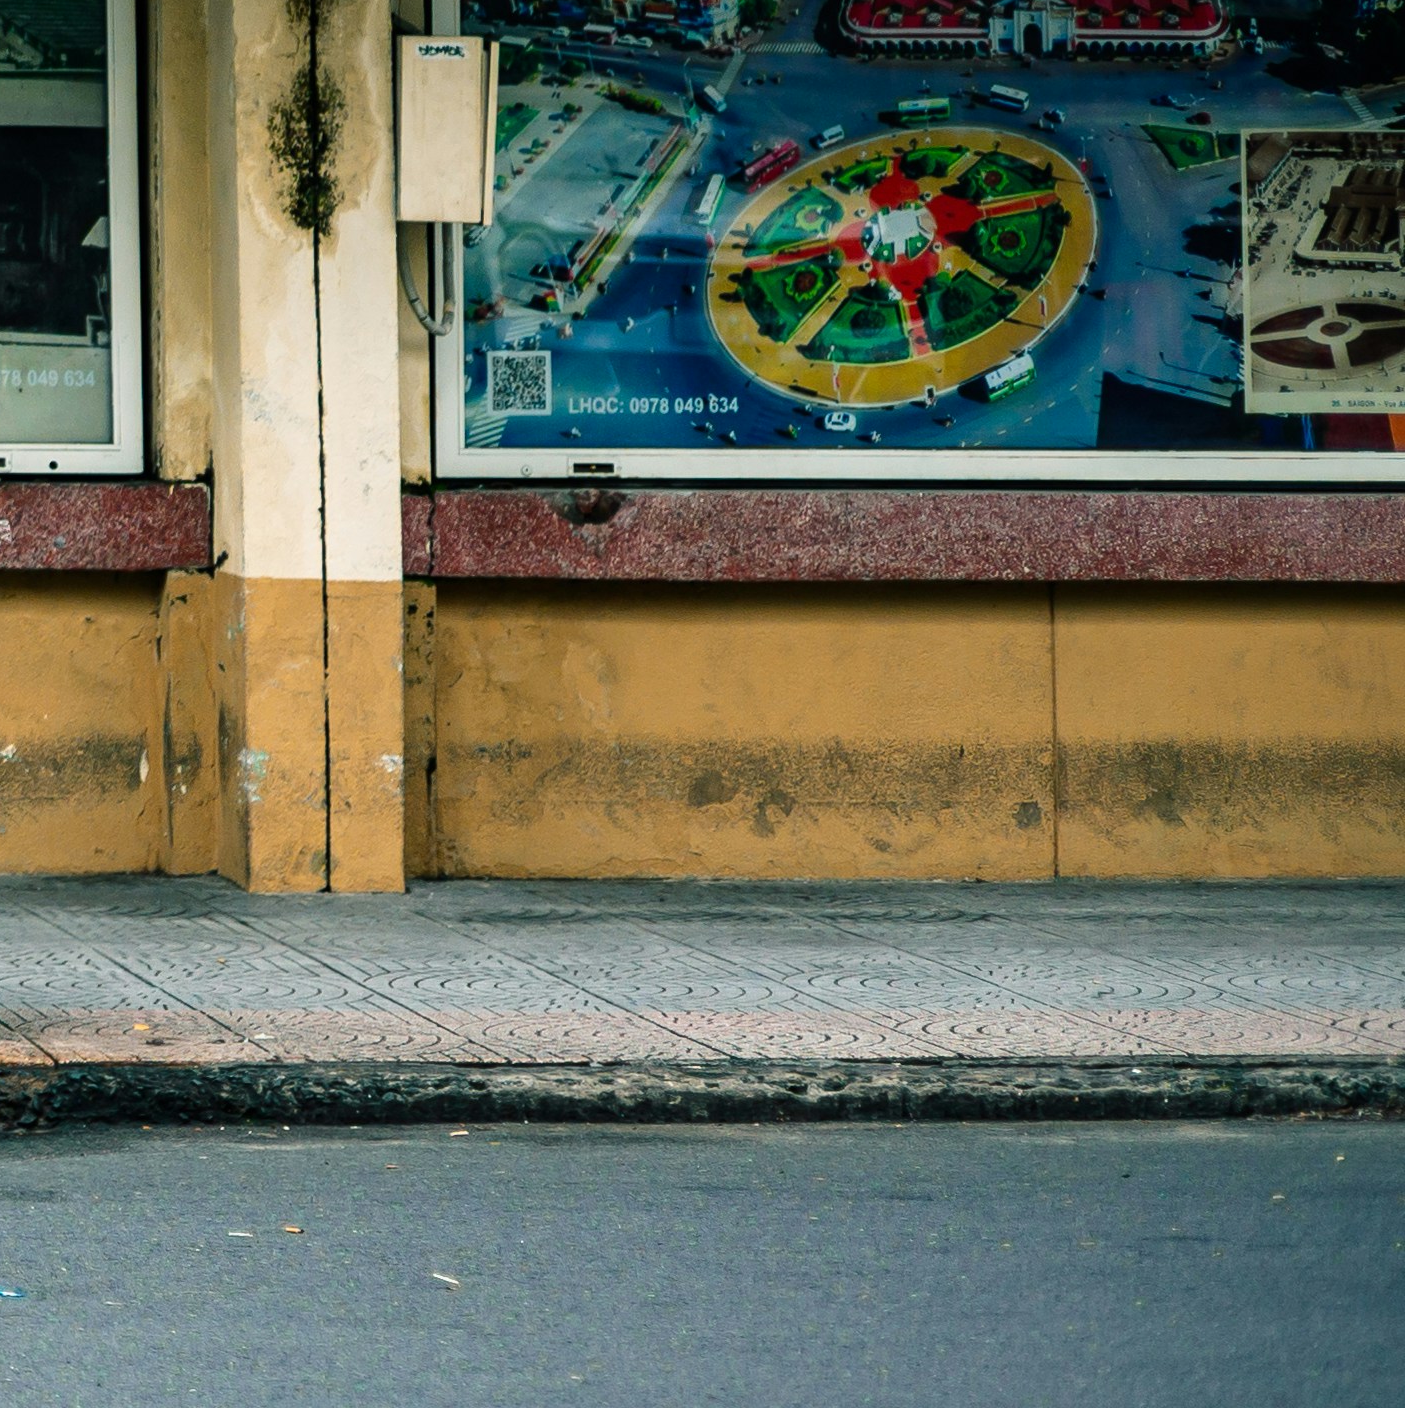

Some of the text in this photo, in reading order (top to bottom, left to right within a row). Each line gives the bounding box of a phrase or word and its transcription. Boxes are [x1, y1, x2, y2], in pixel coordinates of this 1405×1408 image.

[27, 369, 59, 387] 049
[63, 369, 96, 387] 634
[568, 396, 739, 414] LHQC: 0978 049 634
